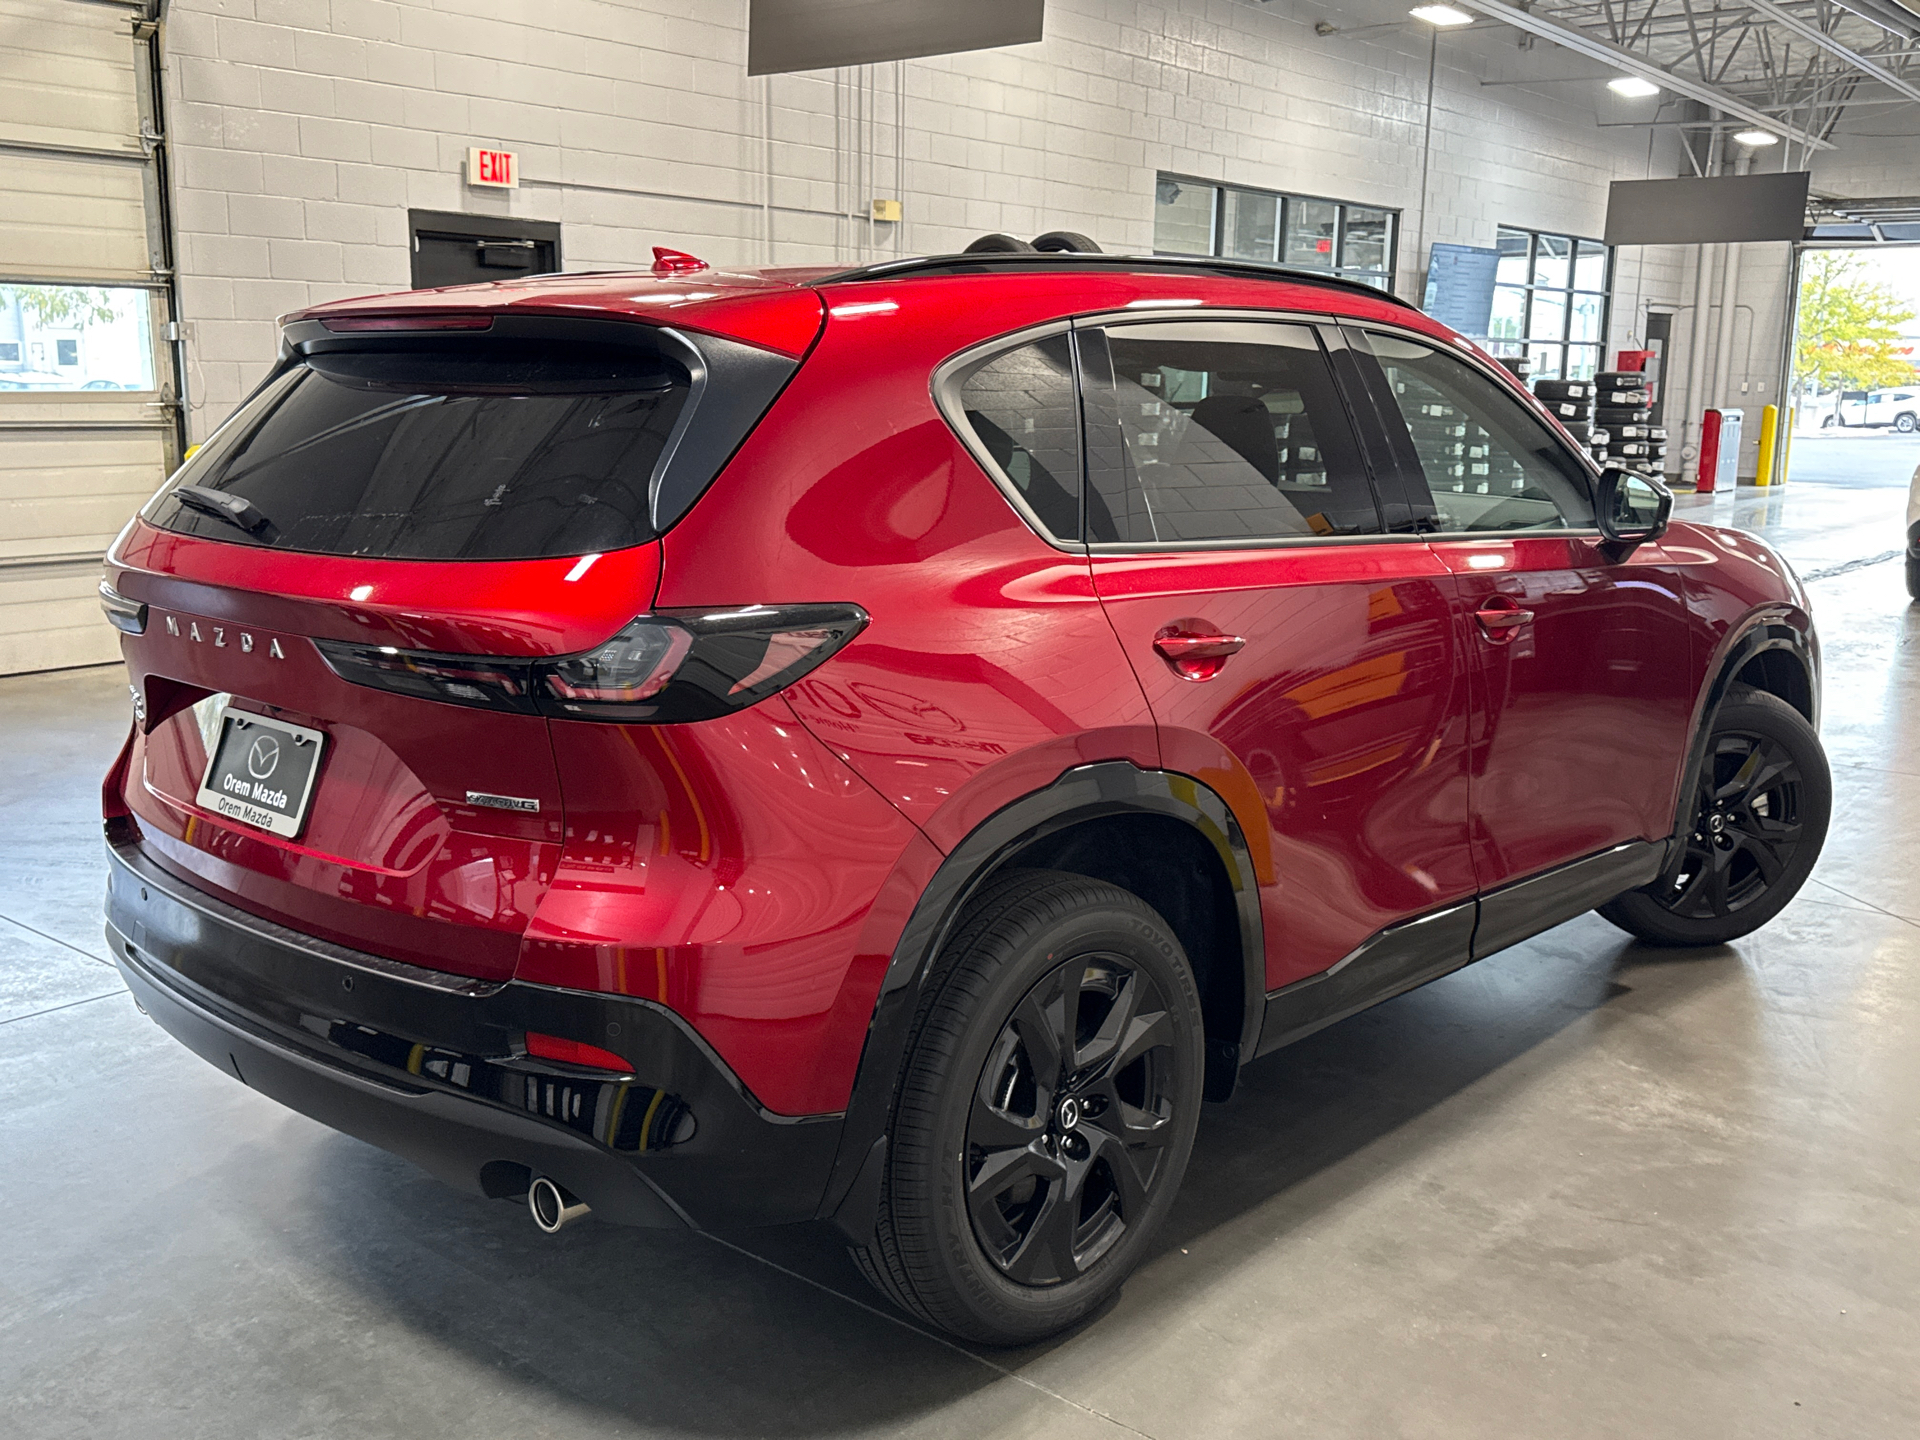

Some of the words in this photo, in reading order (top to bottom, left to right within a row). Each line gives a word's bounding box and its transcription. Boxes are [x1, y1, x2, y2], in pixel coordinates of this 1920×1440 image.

[479, 150, 511, 184] EXIT
[166, 616, 285, 660] MAZDA
[223, 773, 251, 797] Orem
[251, 782, 288, 809] Mazda
[218, 797, 242, 817] Orem
[242, 805, 273, 828] Mazda
[1131, 919, 1174, 957] TOYO
